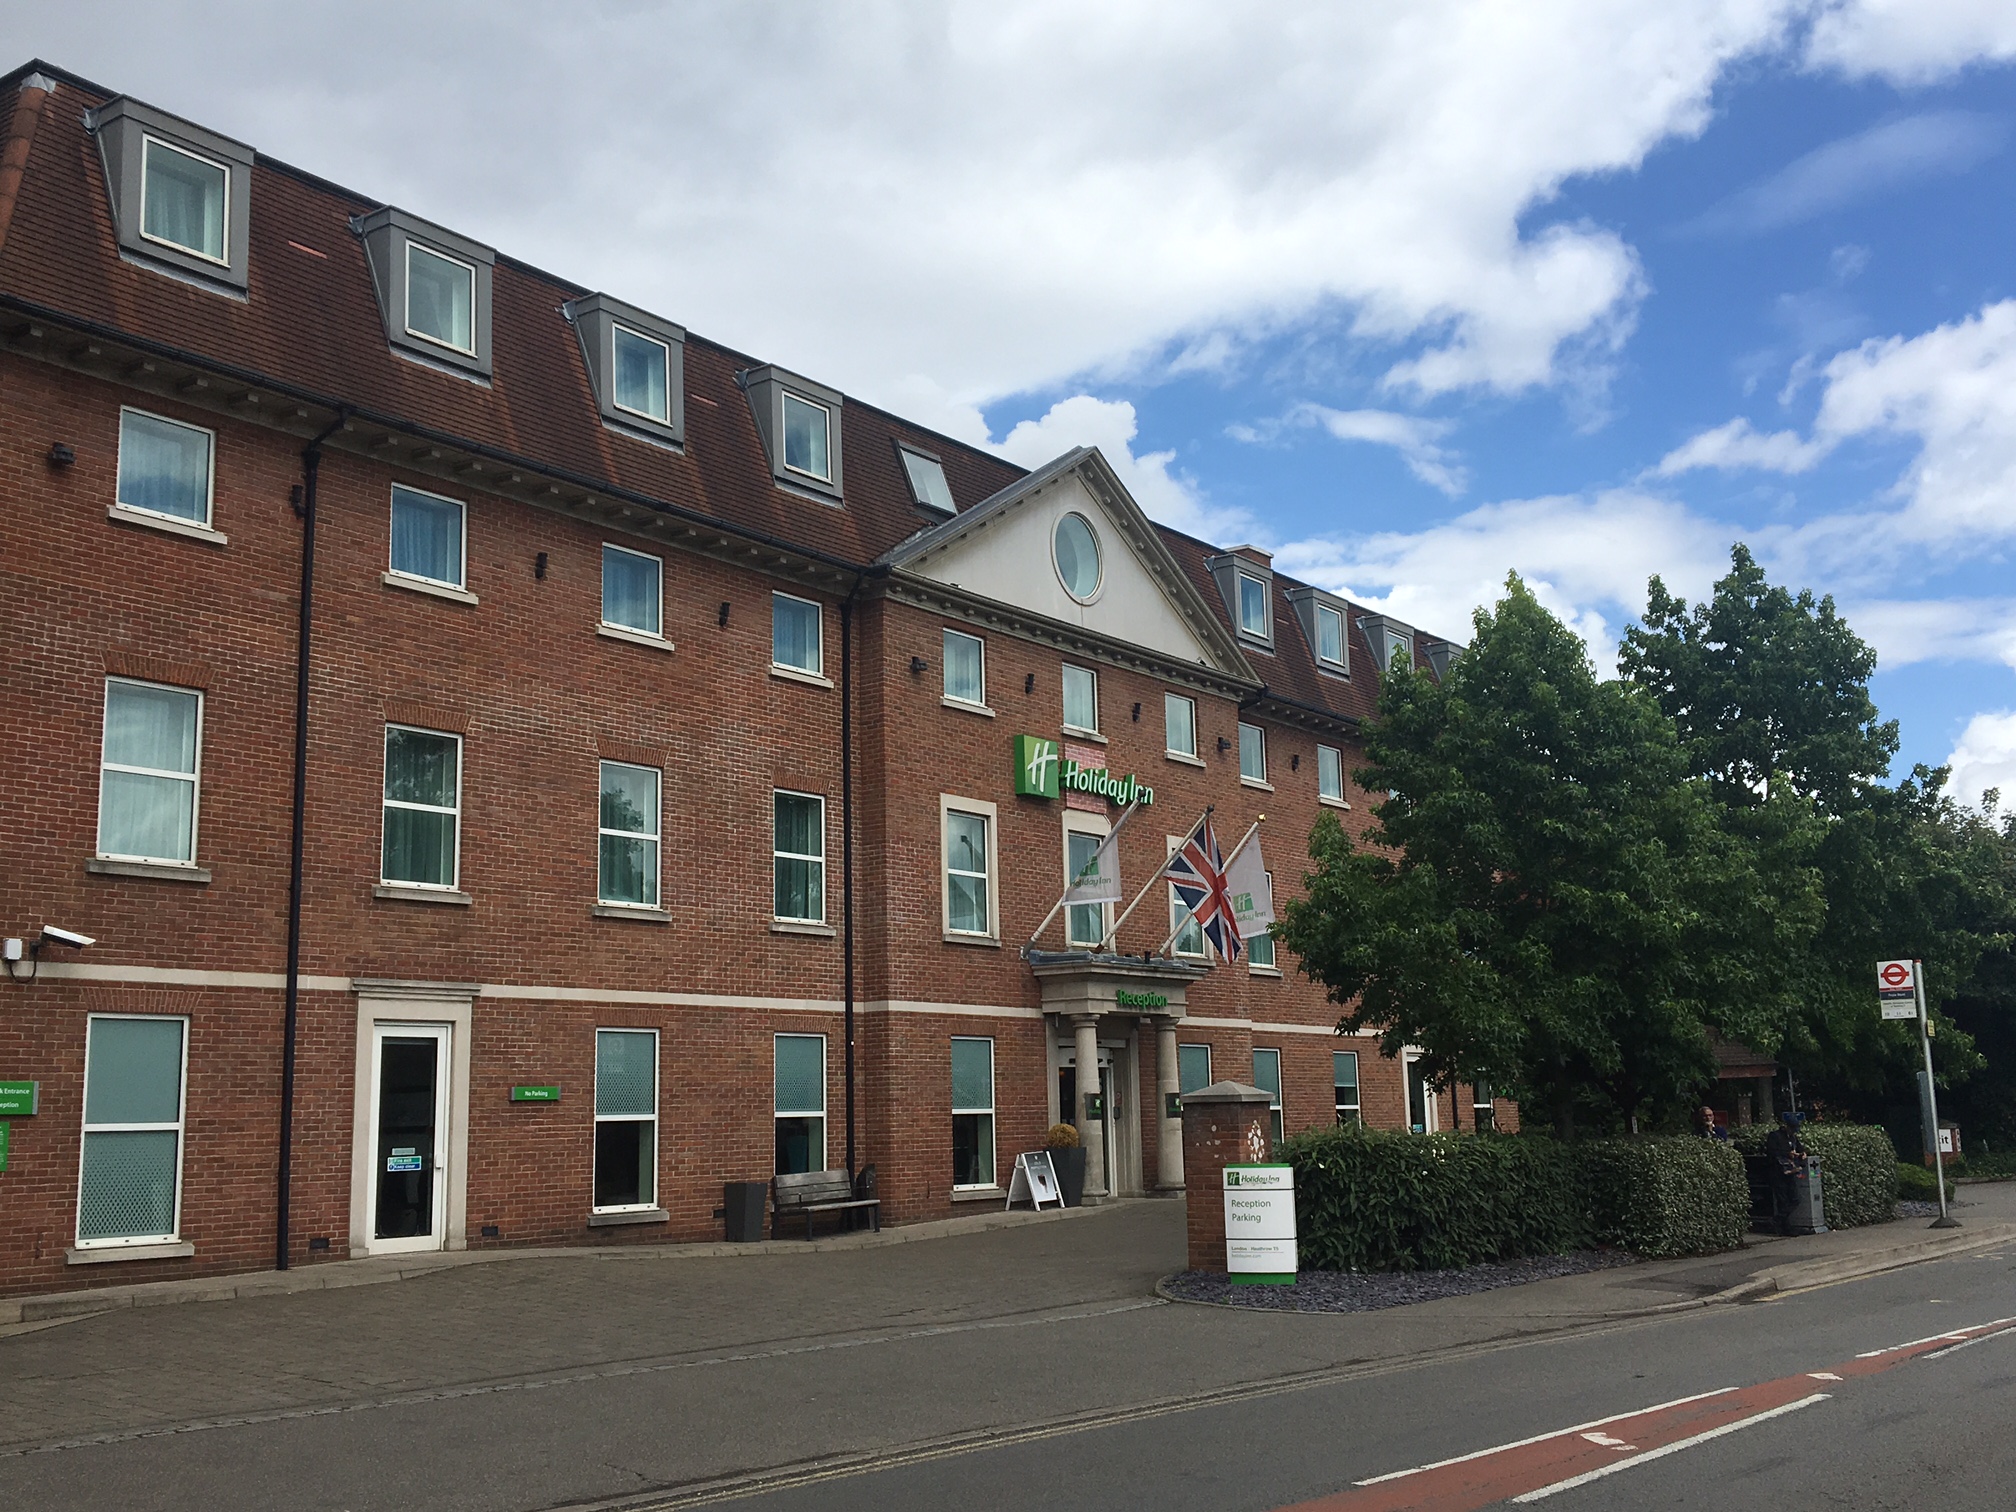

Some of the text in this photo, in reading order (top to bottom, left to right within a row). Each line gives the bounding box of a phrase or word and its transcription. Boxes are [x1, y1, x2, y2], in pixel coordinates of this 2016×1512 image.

[1065, 760, 1154, 806] Holiday Inn
[1117, 989, 1168, 1011] Reception
[1241, 1175, 1267, 1184] Holiday
[1231, 1199, 1271, 1209] Reception
[1232, 1213, 1261, 1223] Parking
